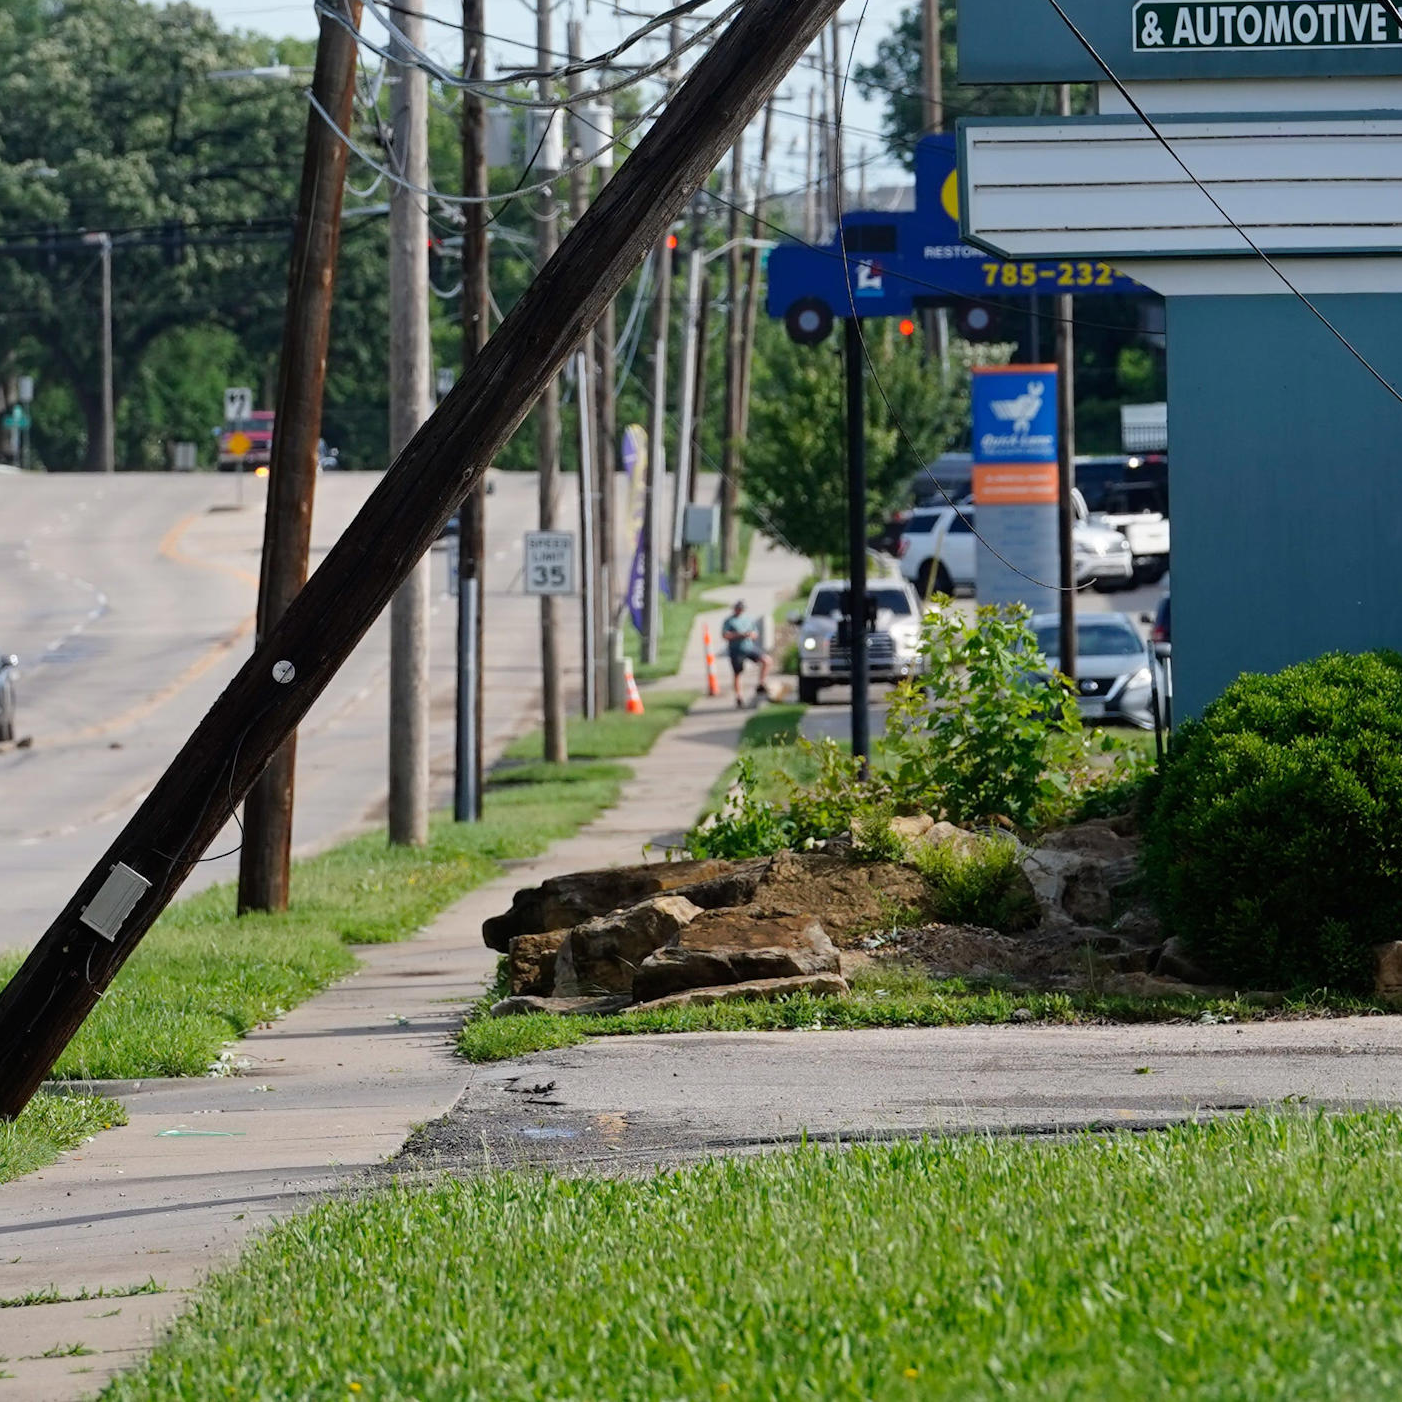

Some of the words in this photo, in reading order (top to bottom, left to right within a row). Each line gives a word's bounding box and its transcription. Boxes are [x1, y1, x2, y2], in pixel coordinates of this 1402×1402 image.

[1141, 10, 1165, 45] &
[1172, 4, 1387, 45] AUTOMOTIVE
[533, 552, 565, 563] LIMIT
[533, 565, 567, 588] 35
